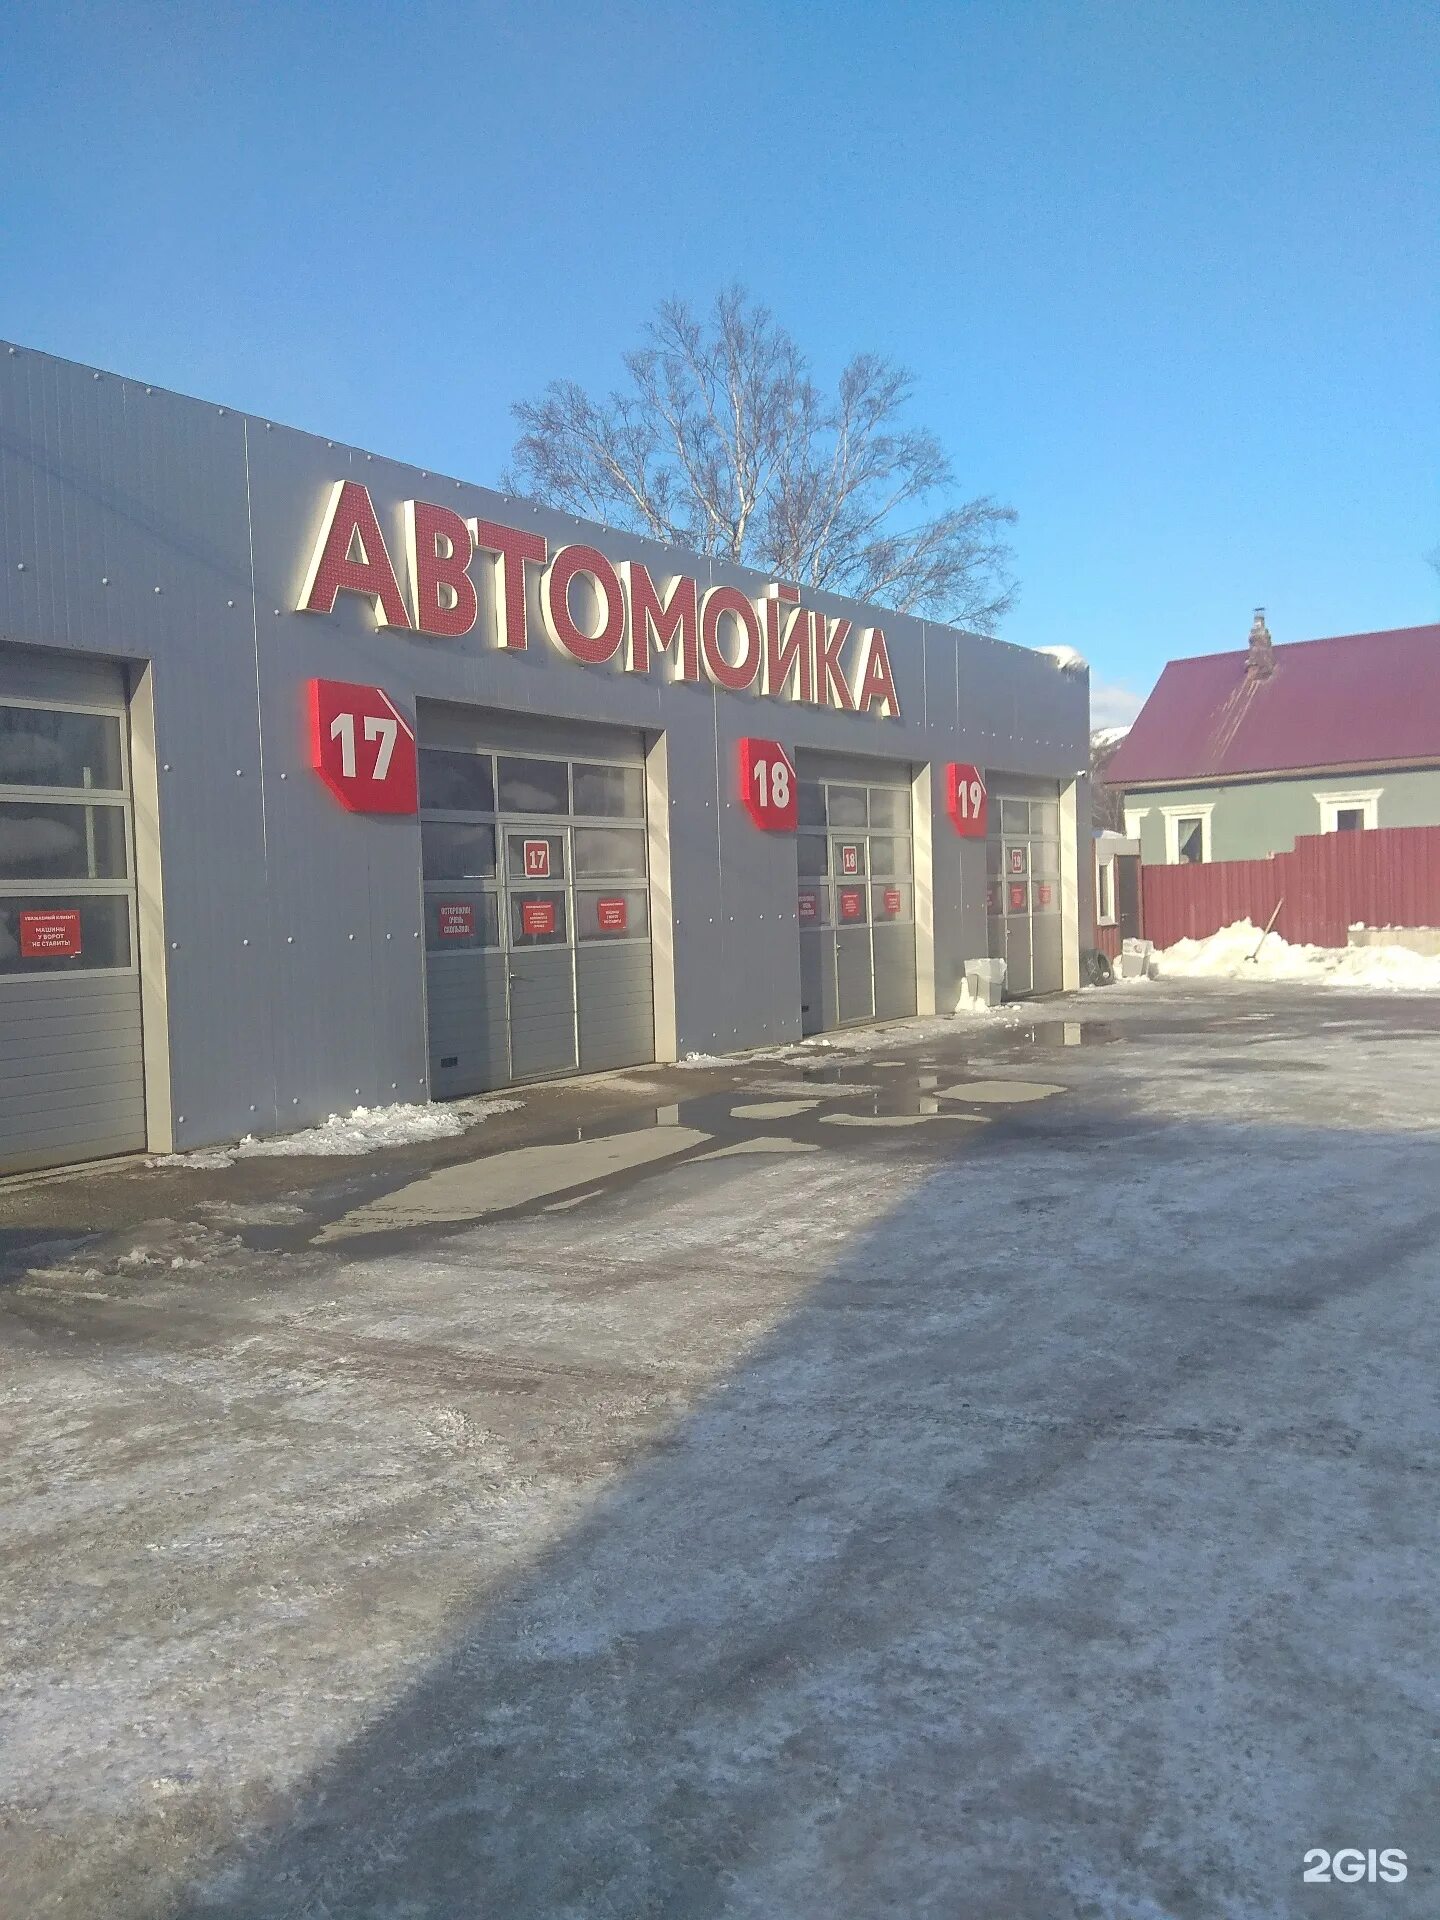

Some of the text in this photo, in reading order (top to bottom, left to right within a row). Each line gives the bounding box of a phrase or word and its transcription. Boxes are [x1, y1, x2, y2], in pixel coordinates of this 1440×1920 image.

[296, 479, 901, 717] АВТОМОЙКА
[330, 712, 398, 781] 17
[753, 759, 790, 808] 18
[958, 780, 982, 819] 19
[529, 850, 546, 869] 17
[845, 853, 856, 868] 18
